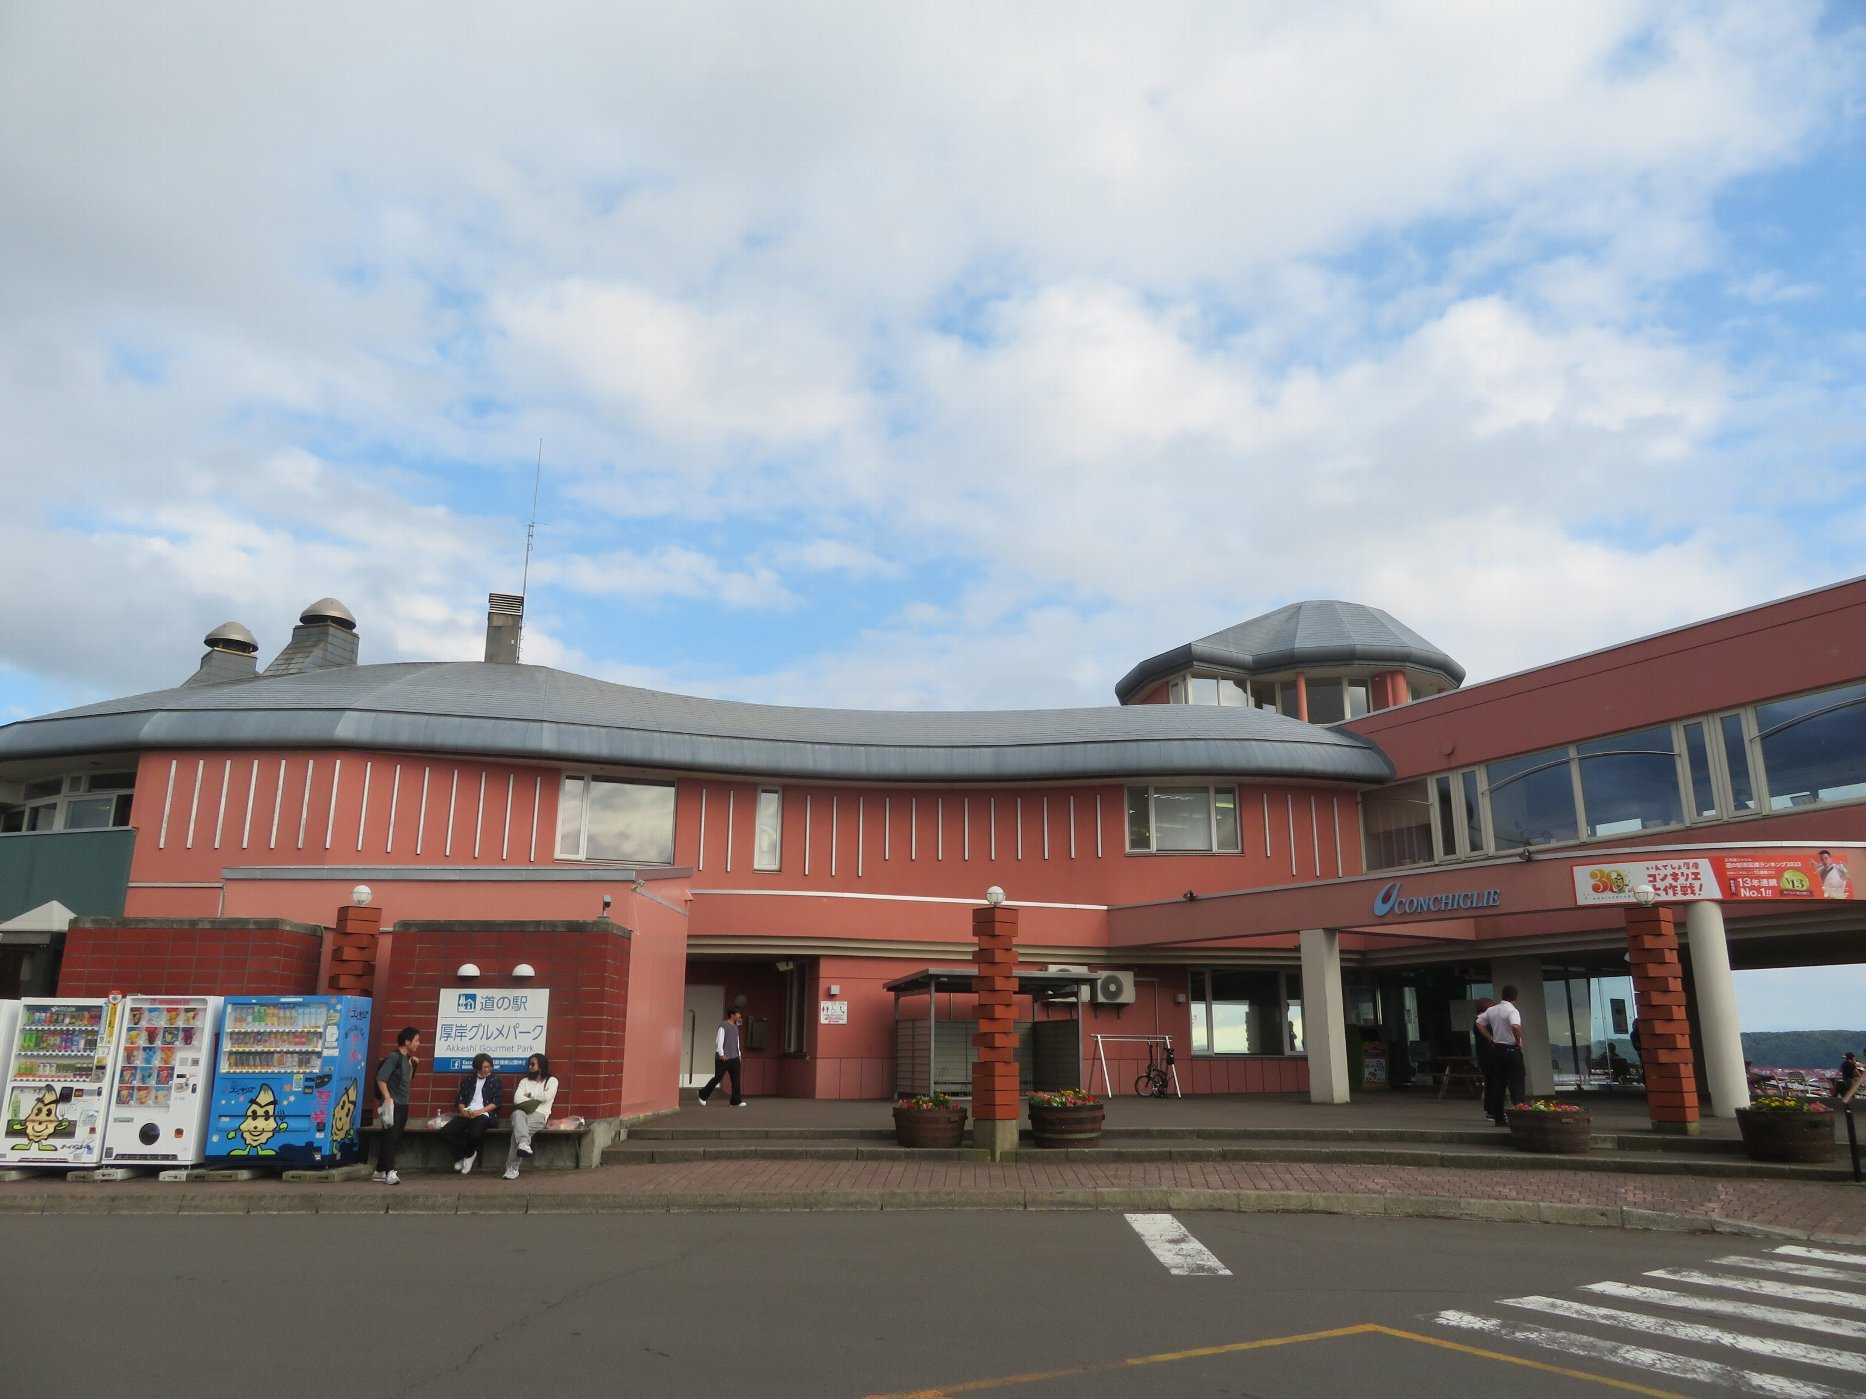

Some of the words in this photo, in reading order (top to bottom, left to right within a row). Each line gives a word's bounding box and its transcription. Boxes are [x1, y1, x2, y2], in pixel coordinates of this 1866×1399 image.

[1647, 871, 1702, 884] コンキリエ
[1394, 888, 1501, 914] CONCHIGLIE
[479, 995, 528, 1012] 道の駅
[439, 1022, 544, 1041] 厚岸グルメパーク
[480, 1044, 514, 1052] Gourmet
[517, 1044, 535, 1052] Park
